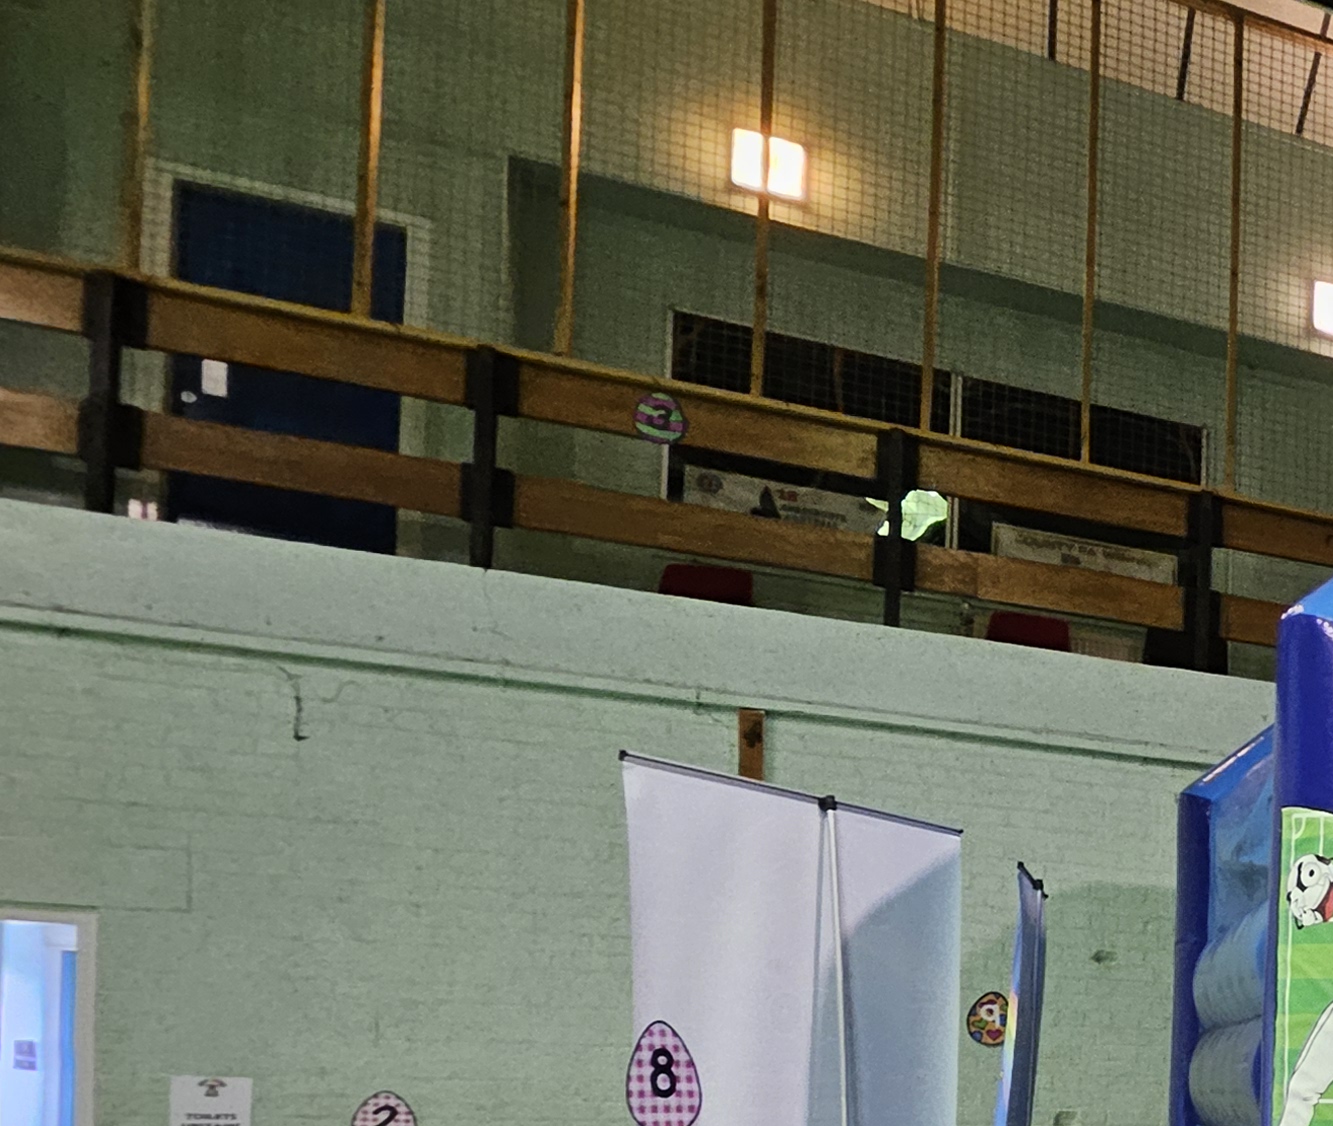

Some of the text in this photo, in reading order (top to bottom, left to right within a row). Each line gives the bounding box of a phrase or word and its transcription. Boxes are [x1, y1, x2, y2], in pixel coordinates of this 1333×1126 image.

[646, 405, 673, 430] 3
[980, 1004, 1000, 1029] 9
[650, 1047, 676, 1098] 8
